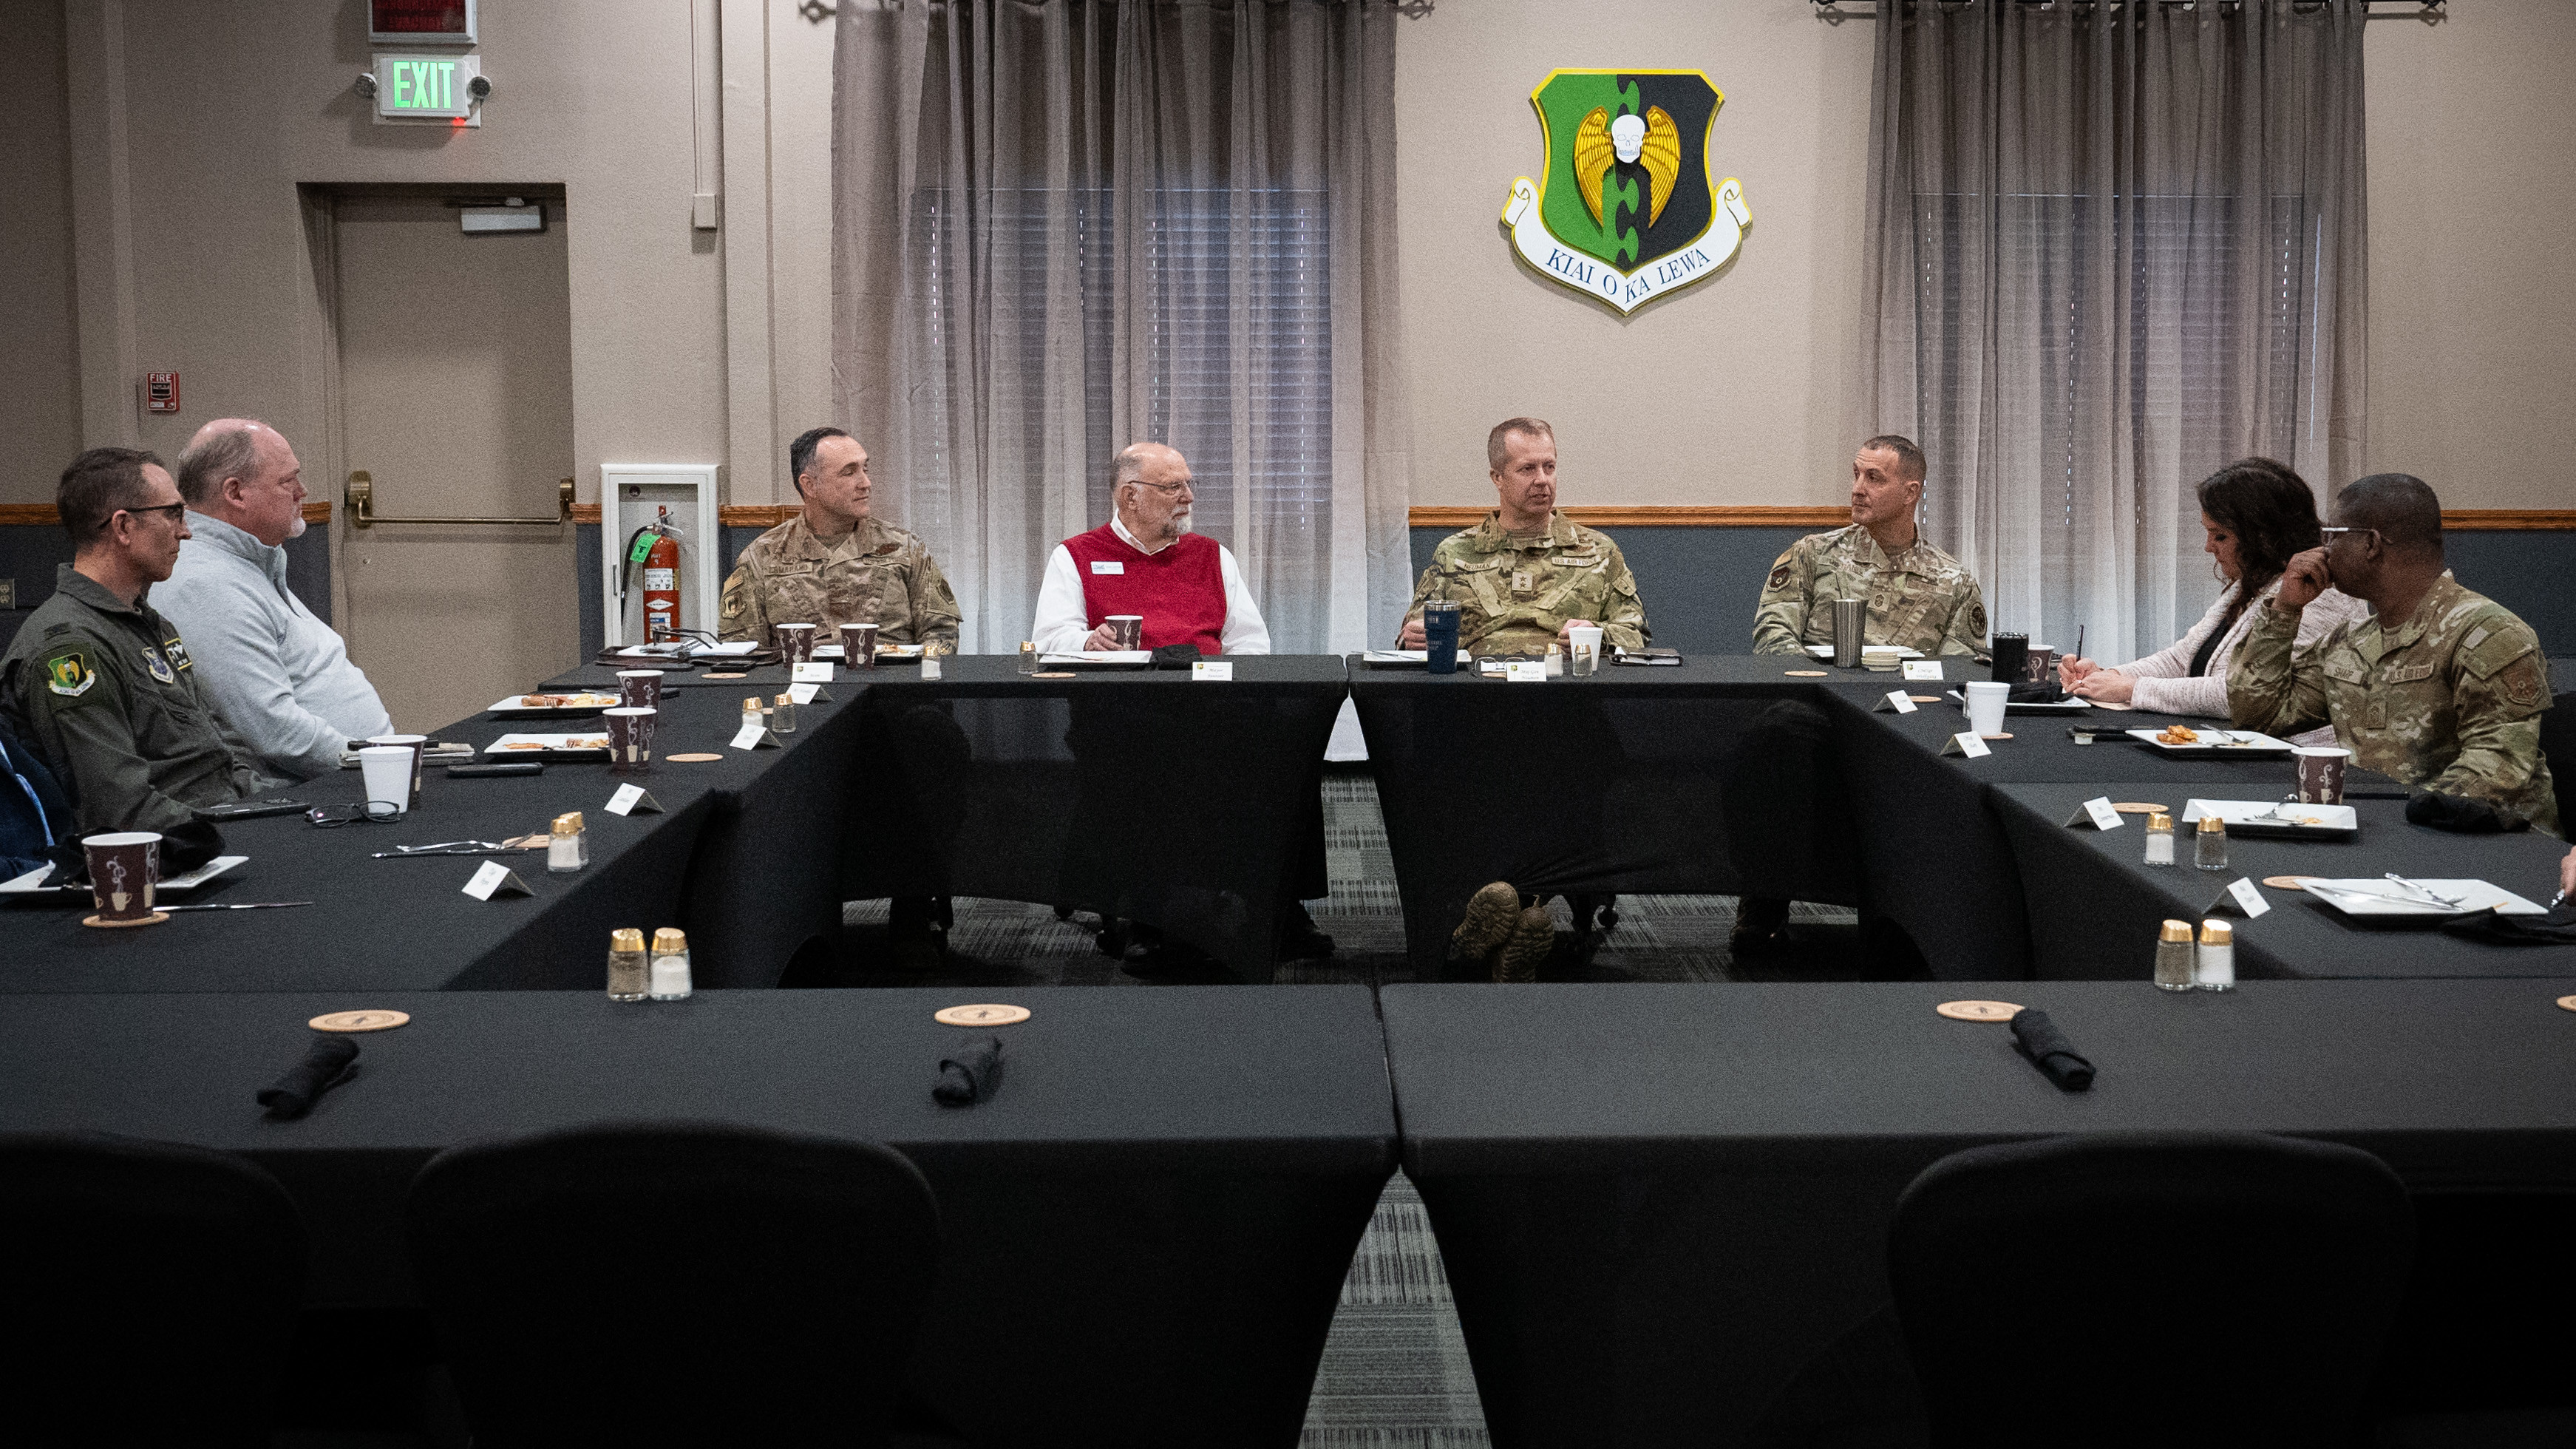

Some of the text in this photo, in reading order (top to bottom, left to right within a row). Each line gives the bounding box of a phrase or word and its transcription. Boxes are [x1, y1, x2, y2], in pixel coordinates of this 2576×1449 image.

[394, 62, 455, 108] EXIT
[1546, 248, 1710, 305] KIAI O KA LEWA
[149, 373, 172, 383] FIRE
[1464, 563, 1491, 571] NEUMAN
